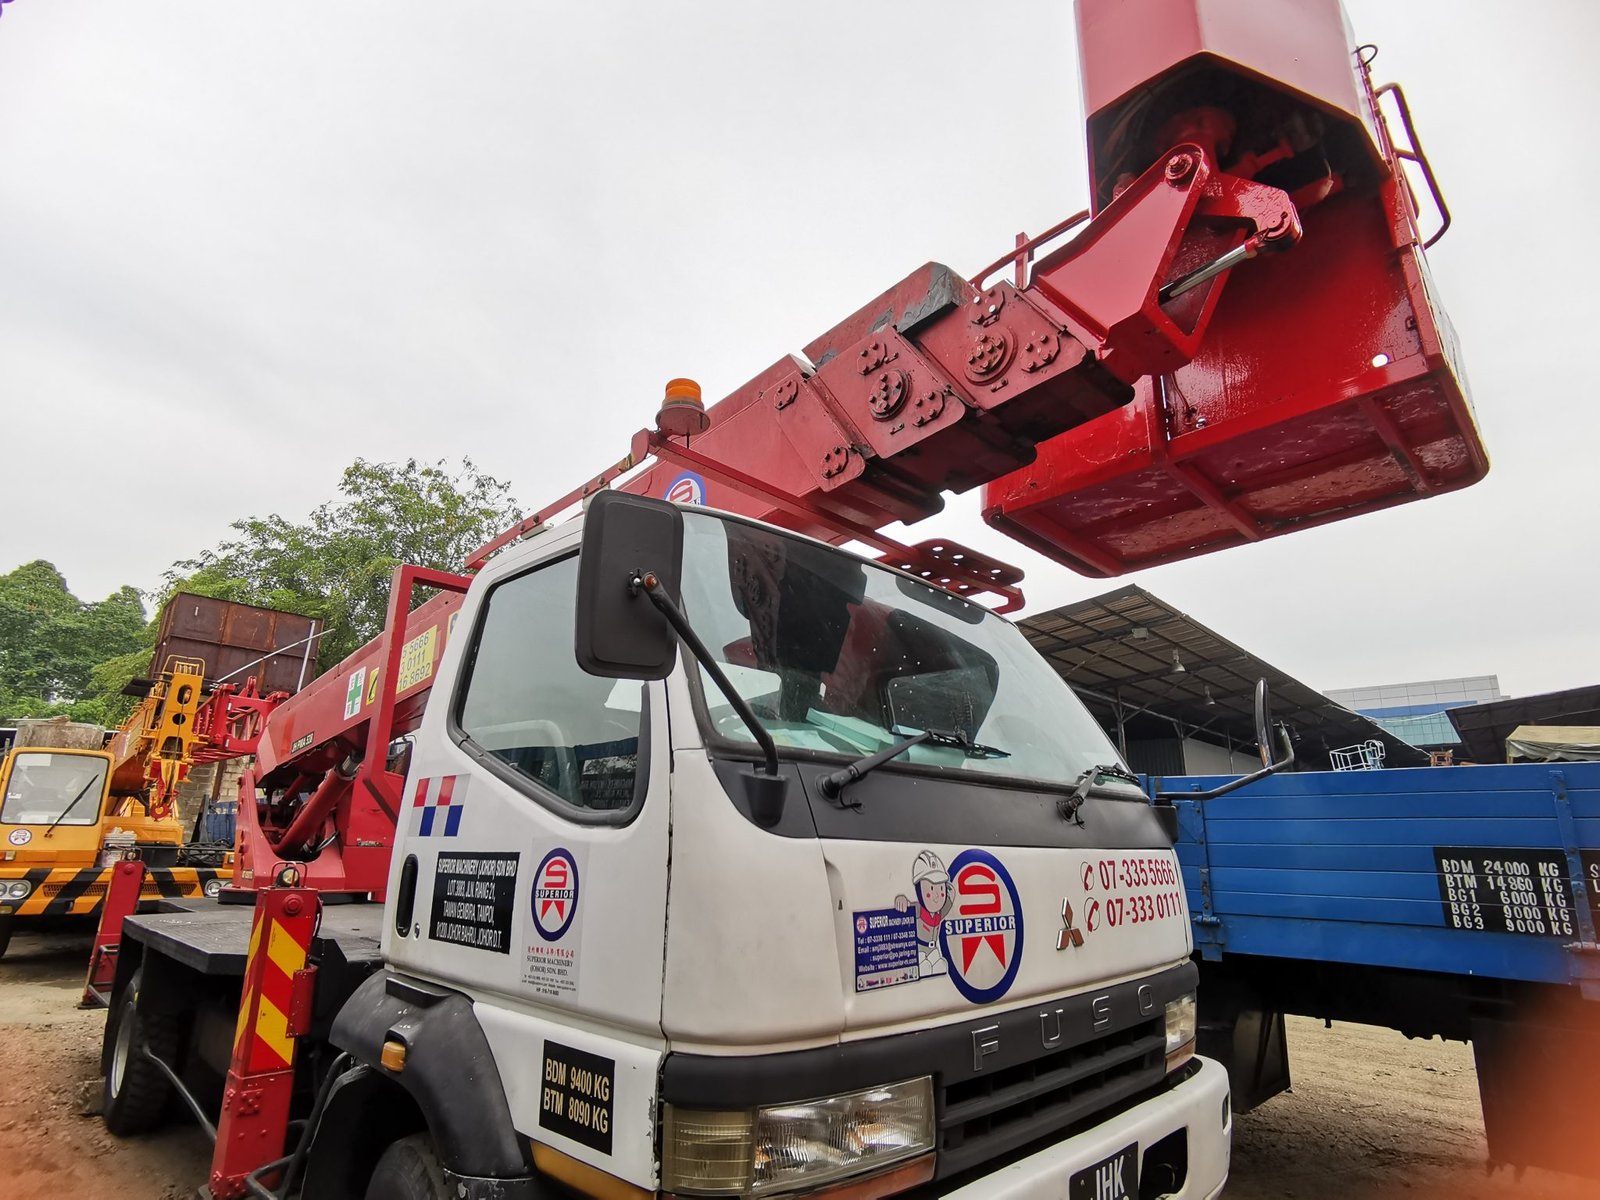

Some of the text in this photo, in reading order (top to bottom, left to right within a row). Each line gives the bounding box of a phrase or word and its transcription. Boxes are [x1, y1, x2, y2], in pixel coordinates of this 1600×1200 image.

[410, 662, 431, 686] 8692
[437, 858, 517, 880] SUPERIOR MACHINERY (JOHOR) SDN BHD
[1441, 858, 1559, 877] BDM 24000 KG
[447, 879, 457, 896] LOT
[1445, 874, 1478, 889] BTM
[1541, 877, 1564, 893] KG
[535, 890, 574, 899] SUPERIOR
[1448, 888, 1566, 908] BG1 6000 KG
[443, 900, 458, 918] TAMAN
[1106, 891, 1182, 927] 07-333 0111
[1451, 901, 1570, 922] BG2 9000 KG
[869, 916, 888, 928] SUPERIOR
[944, 915, 1017, 935] SUPERIOR
[1452, 915, 1573, 935] BG3 9000 KG
[446, 923, 462, 941] JOHOR
[476, 927, 493, 946] JOHOR
[858, 945, 870, 954] Email
[527, 955, 573, 967] SUPERIOR MACHINERY
[971, 984, 1152, 1071] FUSO
[545, 1058, 610, 1102] BDM 9400 KG
[543, 1087, 608, 1134] BTM 8090 KG
